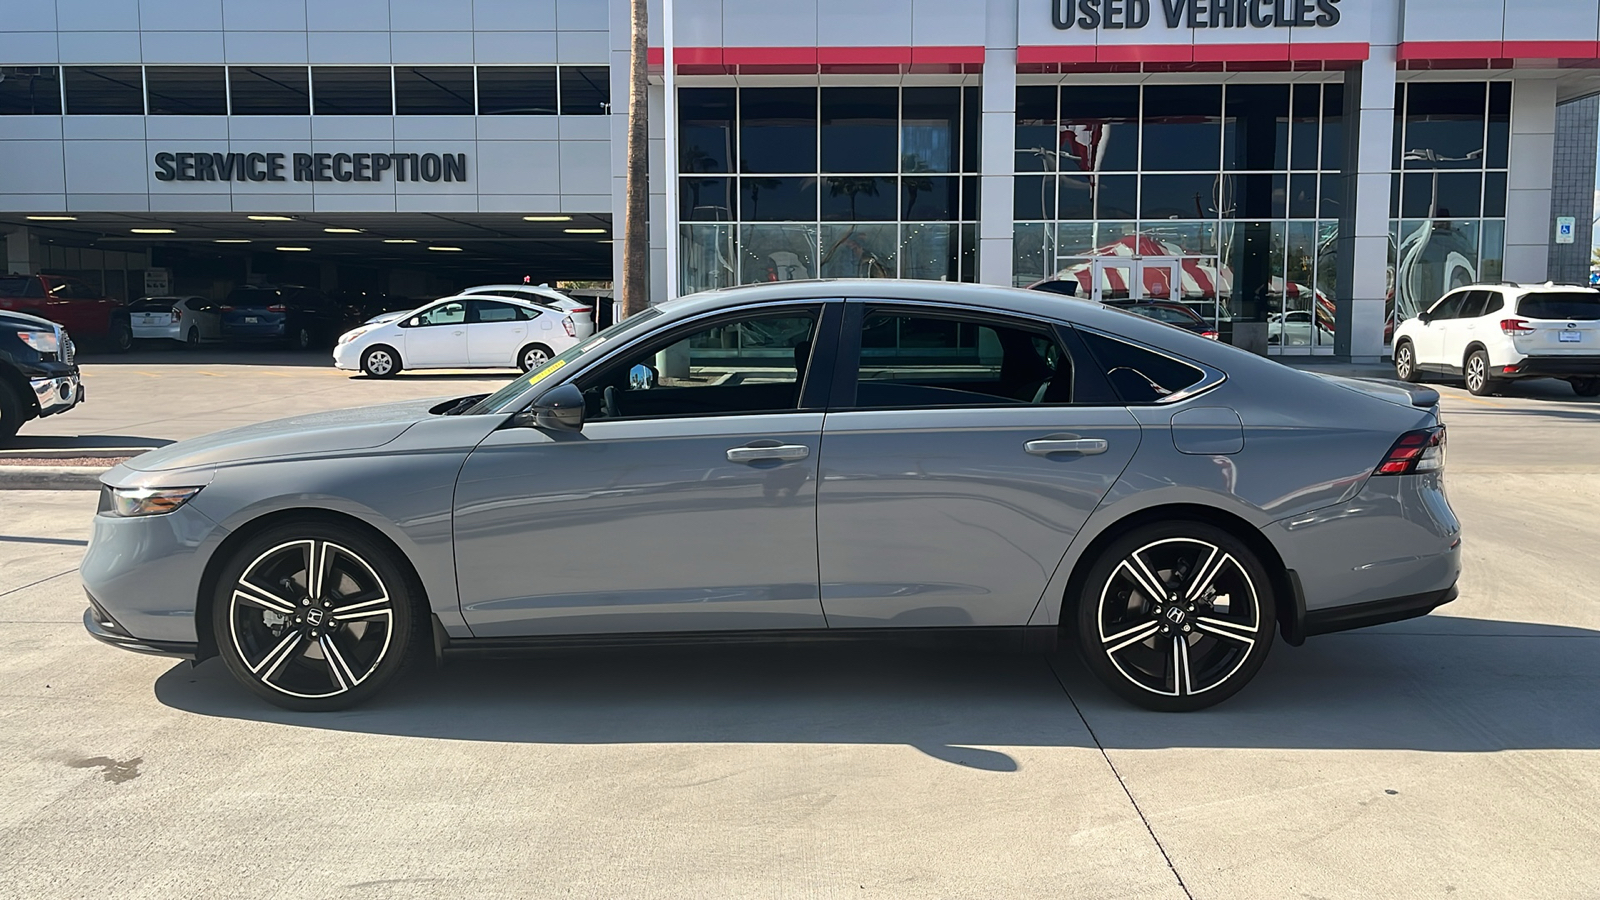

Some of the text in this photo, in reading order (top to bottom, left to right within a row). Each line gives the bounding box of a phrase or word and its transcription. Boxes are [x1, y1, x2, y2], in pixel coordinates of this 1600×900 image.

[1051, 0, 1341, 30] USED VEHICLES
[155, 152, 467, 182] SERVICE RECEPTION
